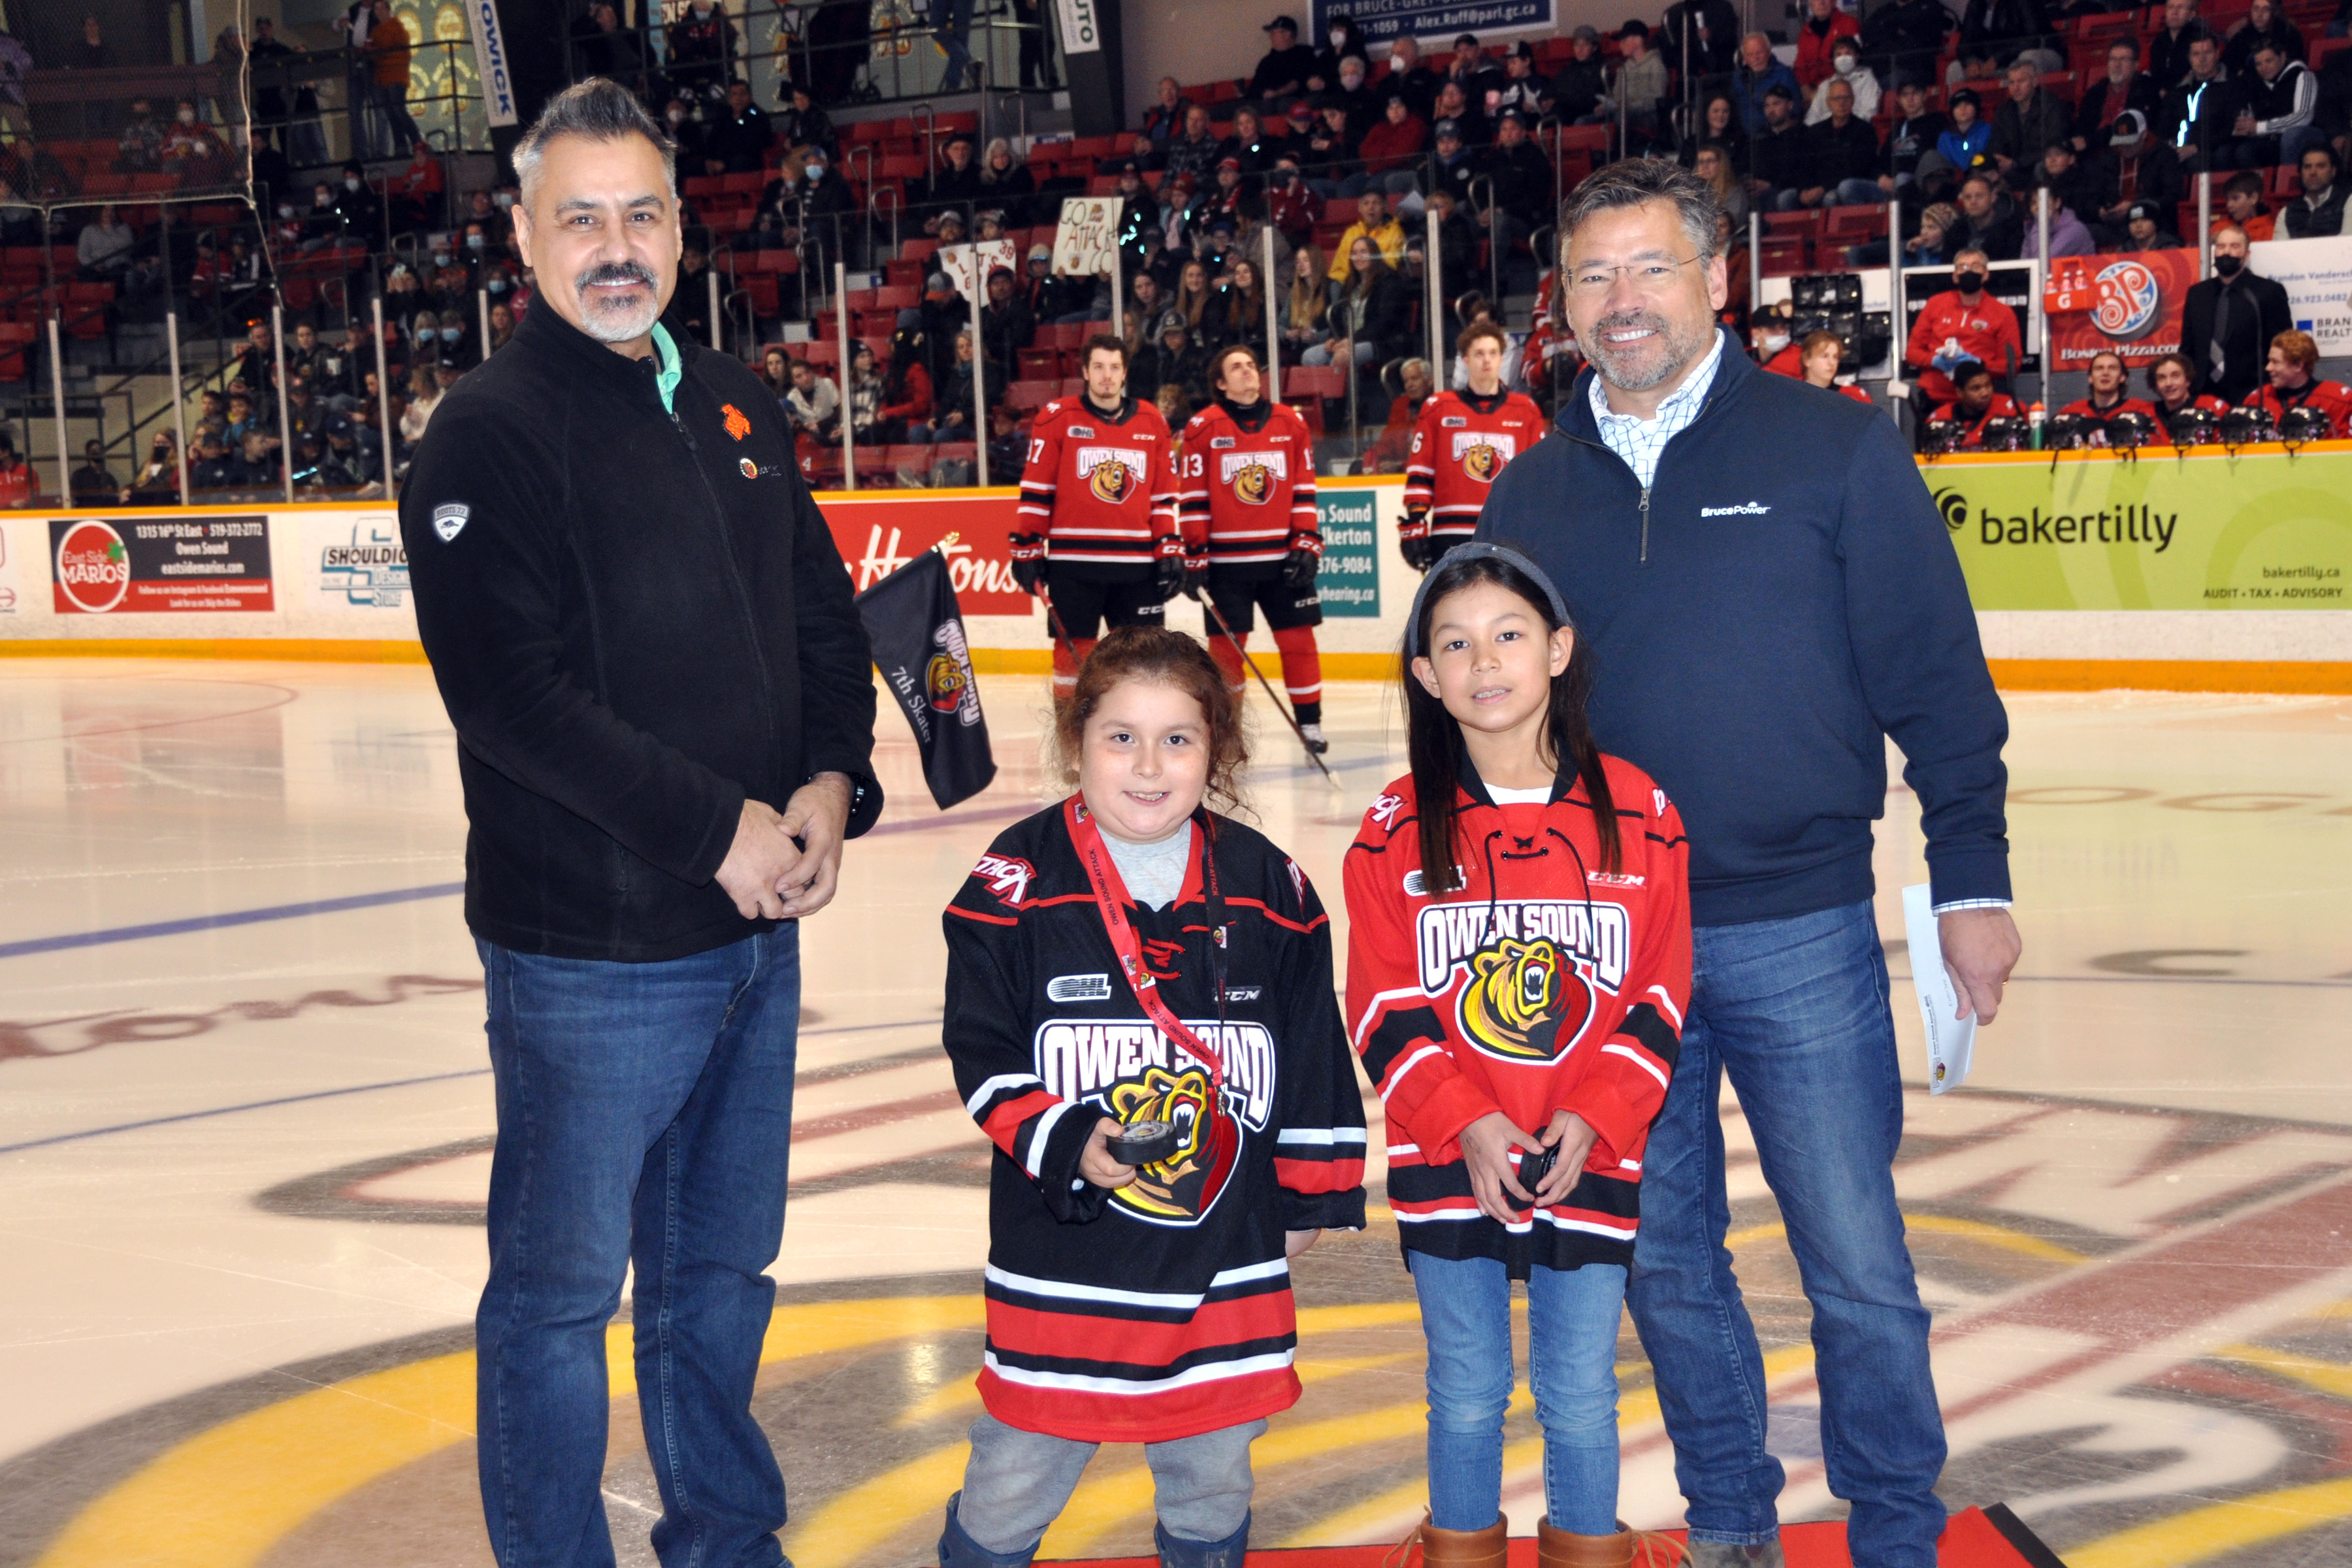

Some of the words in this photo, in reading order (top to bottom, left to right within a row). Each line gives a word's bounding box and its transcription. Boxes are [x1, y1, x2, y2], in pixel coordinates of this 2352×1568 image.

[1075, 0, 1094, 43] UTO
[1359, 22, 1399, 34] 1-1059
[1414, 5, 1536, 29] Alex.Ruff@parl.gc.ca
[481, 0, 512, 115] OWICK
[2057, 293, 2072, 309] G
[2288, 293, 2347, 304] 26.923.0482
[2317, 317, 2352, 327] BRAN
[1183, 453, 1203, 478] 13
[436, 506, 456, 517] ROOTS
[1328, 504, 1372, 522] Sound
[1701, 504, 1771, 517] BrucePower
[135, 524, 157, 538] 1315
[184, 523, 203, 537] East
[1318, 526, 1372, 545] lkerton
[1980, 504, 2178, 553] bakertilly
[65, 551, 86, 564] East
[87, 549, 108, 564] Side
[175, 542, 202, 556] Owen
[201, 541, 229, 555] Sound
[329, 548, 408, 565] SHOULDIC
[1162, 544, 1186, 555] CC
[161, 559, 245, 575] eastsidemarios.com
[2262, 564, 2341, 581] bakertilly.ca
[1317, 586, 1375, 605] yhearing.ca
[2203, 587, 2239, 599] AUDIT
[2249, 587, 2272, 598] TAX
[2281, 587, 2344, 598] ADVISORY
[891, 666, 915, 695] 7th
[908, 694, 932, 743] Skater
[1088, 848, 1103, 877] ATTACK
[973, 856, 1034, 904] TACK
[1098, 877, 1111, 902] SOUND
[1107, 902, 1119, 926] OWEN
[1423, 906, 1518, 988] OWEN
[1522, 905, 1624, 988] SOUND
[1147, 999, 1170, 1025] ATTACK
[1168, 1024, 1191, 1045] SOUND
[1190, 1042, 1211, 1059] OWEN
[1043, 1026, 1169, 1103] OWEN
